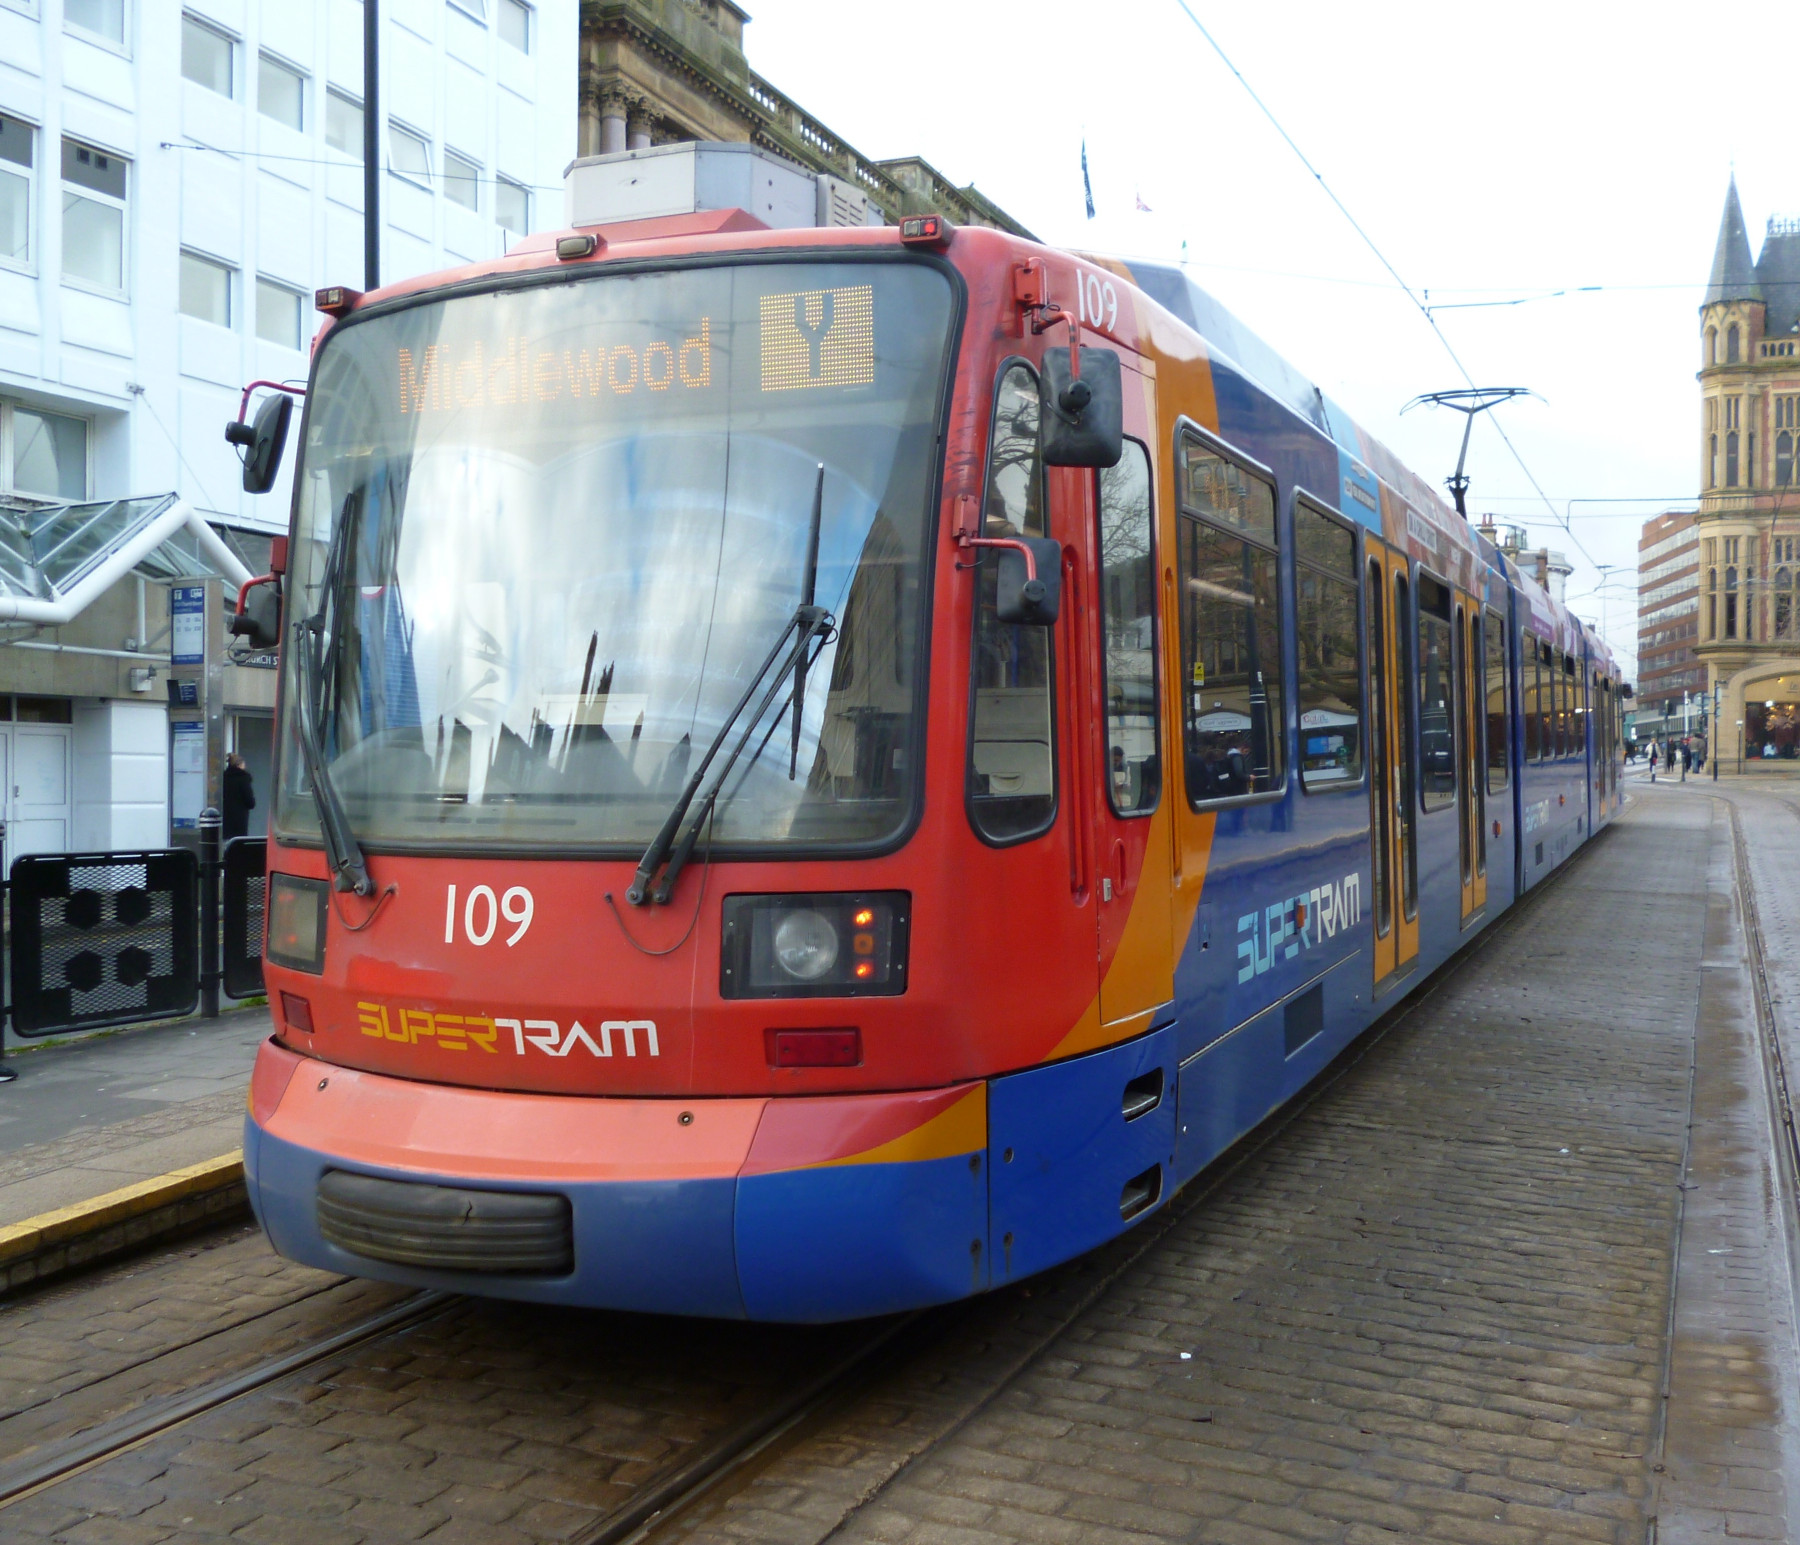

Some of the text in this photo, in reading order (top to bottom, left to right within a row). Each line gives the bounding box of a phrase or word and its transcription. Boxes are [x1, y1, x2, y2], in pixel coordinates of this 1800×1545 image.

[794, 292, 836, 379] Y
[1076, 268, 1118, 333] 109
[399, 316, 711, 413] Middlewood
[444, 884, 534, 947] 109
[1237, 872, 1361, 985] SUPERTRAM
[357, 1001, 660, 1058] SUPERTRAM
